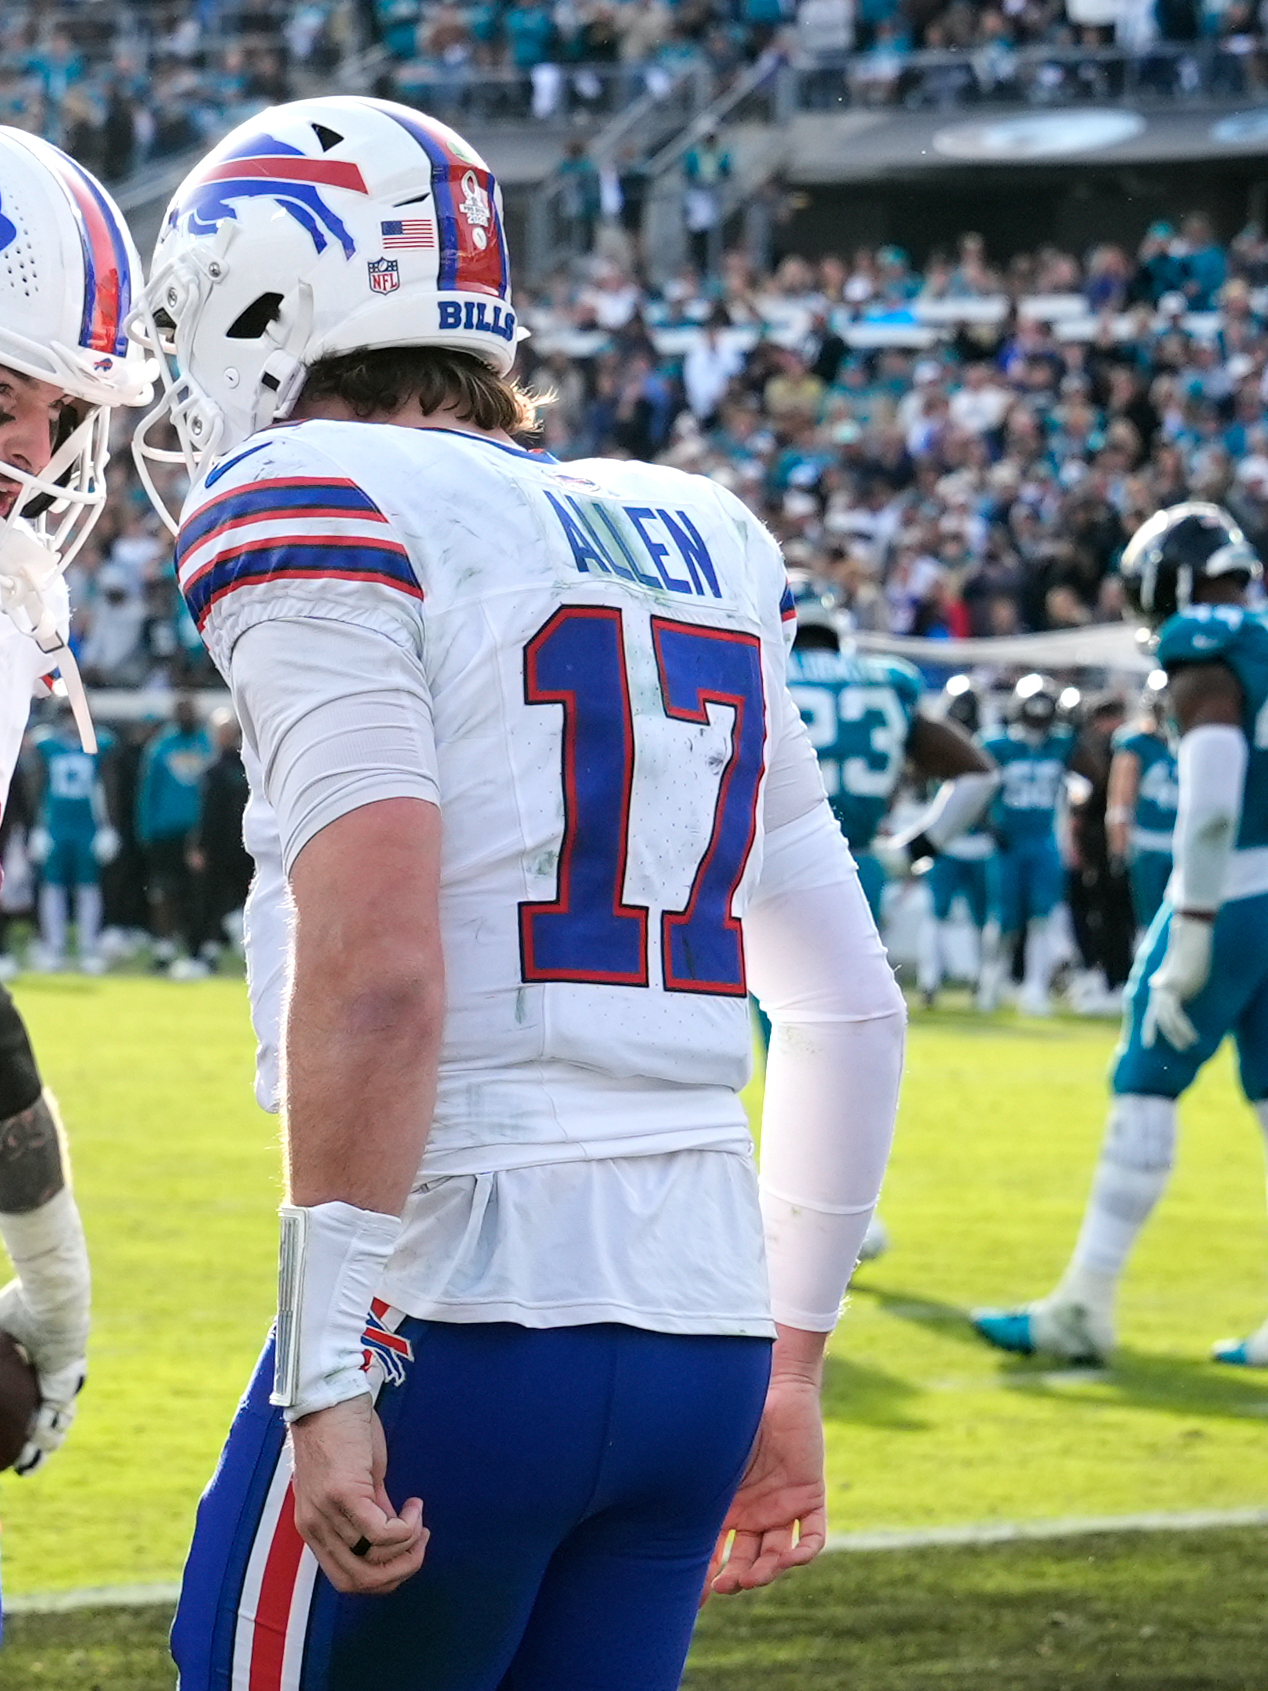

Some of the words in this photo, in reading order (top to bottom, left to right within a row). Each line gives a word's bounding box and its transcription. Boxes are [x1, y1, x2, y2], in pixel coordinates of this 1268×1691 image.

[372, 272, 398, 292] NFL
[437, 300, 516, 342] BILLS
[542, 489, 723, 599] ALLEN
[518, 604, 767, 999] 17
